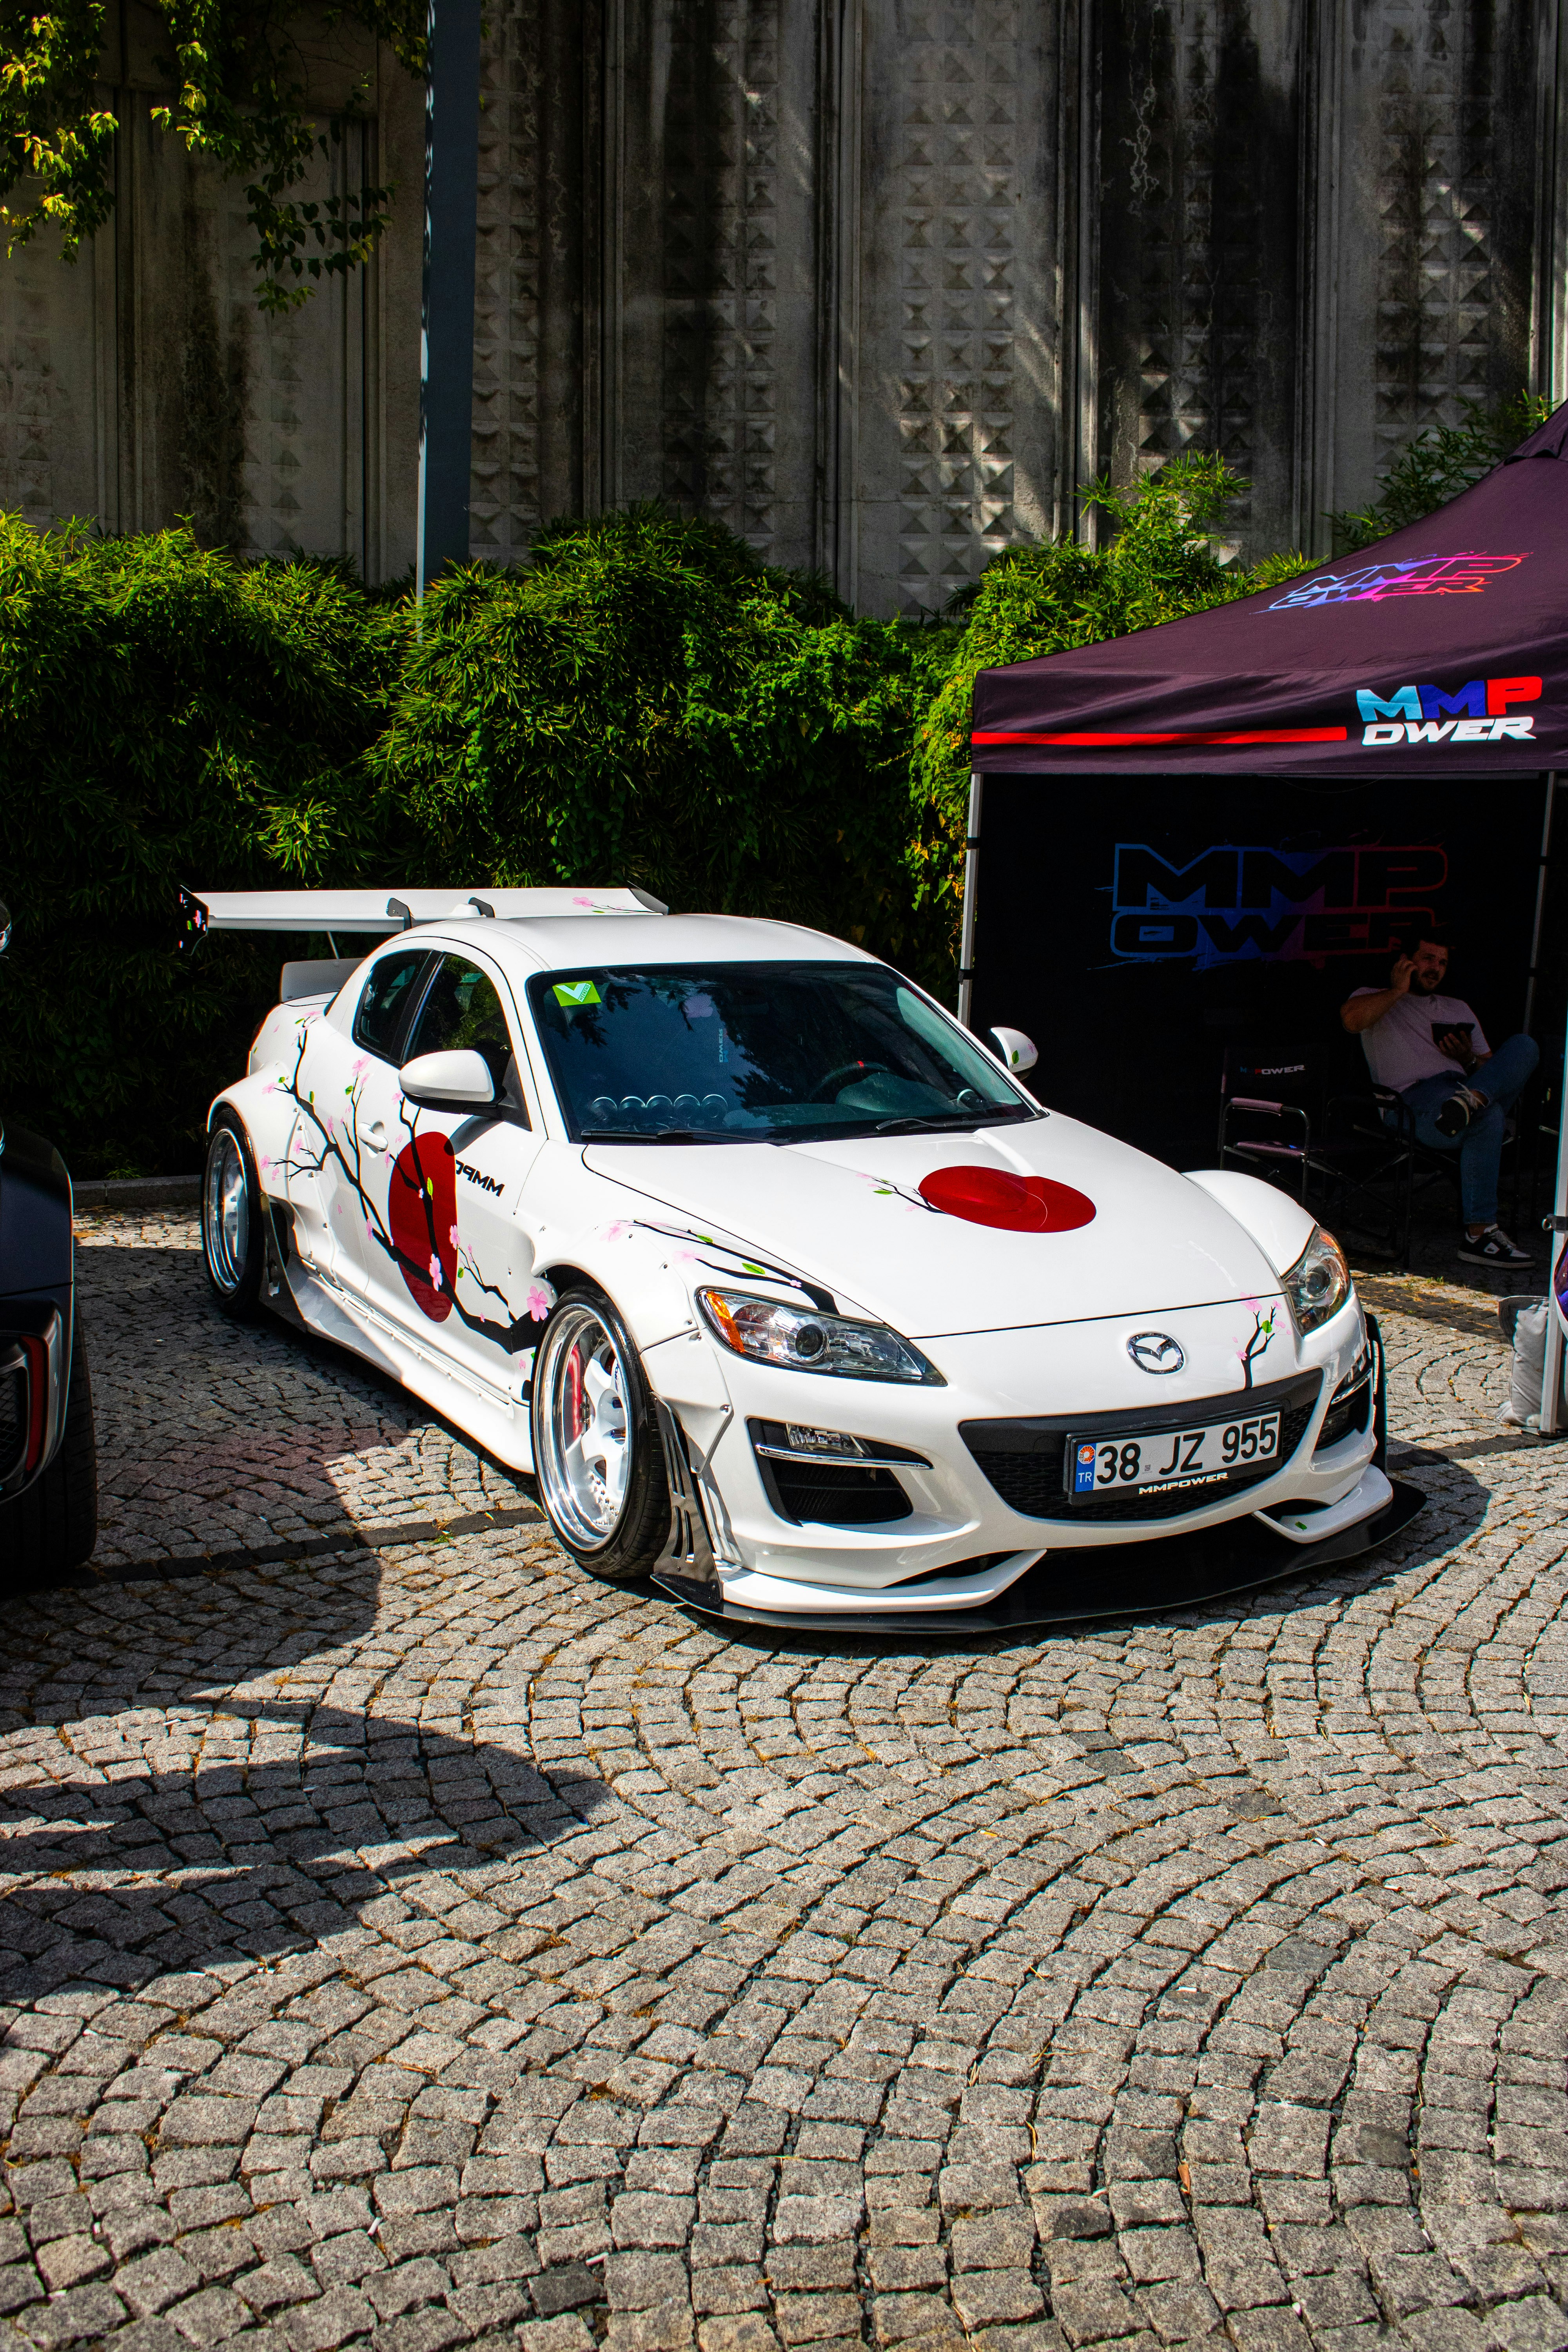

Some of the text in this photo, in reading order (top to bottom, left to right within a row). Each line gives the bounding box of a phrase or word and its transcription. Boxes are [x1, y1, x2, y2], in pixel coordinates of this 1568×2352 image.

[1269, 576, 1485, 609] OWER
[1288, 556, 1523, 597] MMP
[1356, 676, 1543, 721] MMP
[1362, 716, 1537, 746] OWER
[1112, 844, 1448, 911] MMP
[579, 984, 590, 1001] WEEKEND
[1096, 1416, 1278, 1484] 38 JZ 955
[1078, 1472, 1092, 1484] TR
[1139, 1472, 1229, 1495] MMPOWER
